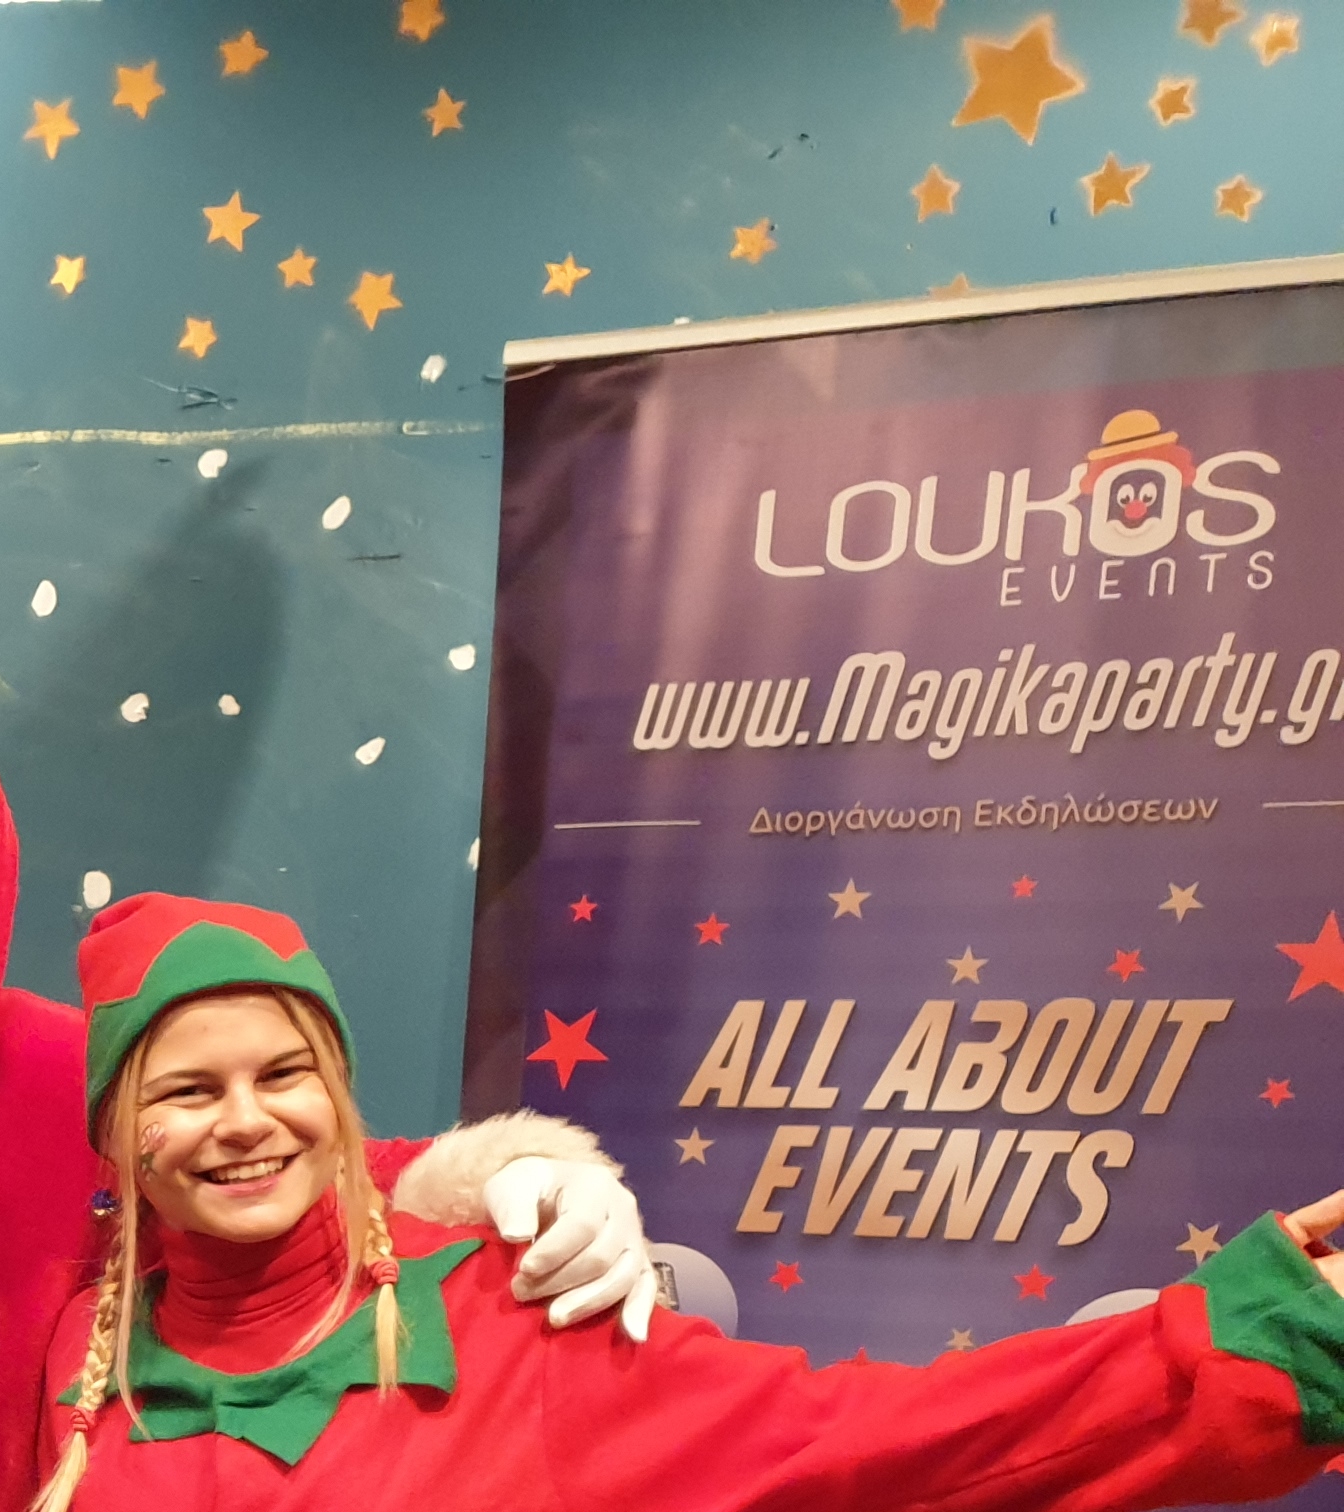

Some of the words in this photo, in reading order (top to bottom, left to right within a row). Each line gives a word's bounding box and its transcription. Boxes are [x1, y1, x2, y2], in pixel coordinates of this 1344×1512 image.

[754, 450, 1282, 577] LOUKOS
[1000, 550, 1276, 607] EVENTS
[749, 801, 962, 837] Διοργάνωση
[974, 792, 1219, 831] Εκδηλώσεων
[679, 999, 857, 1109] ALL
[863, 998, 1235, 1115] ABOUT
[735, 1124, 1135, 1247] EVENTS
